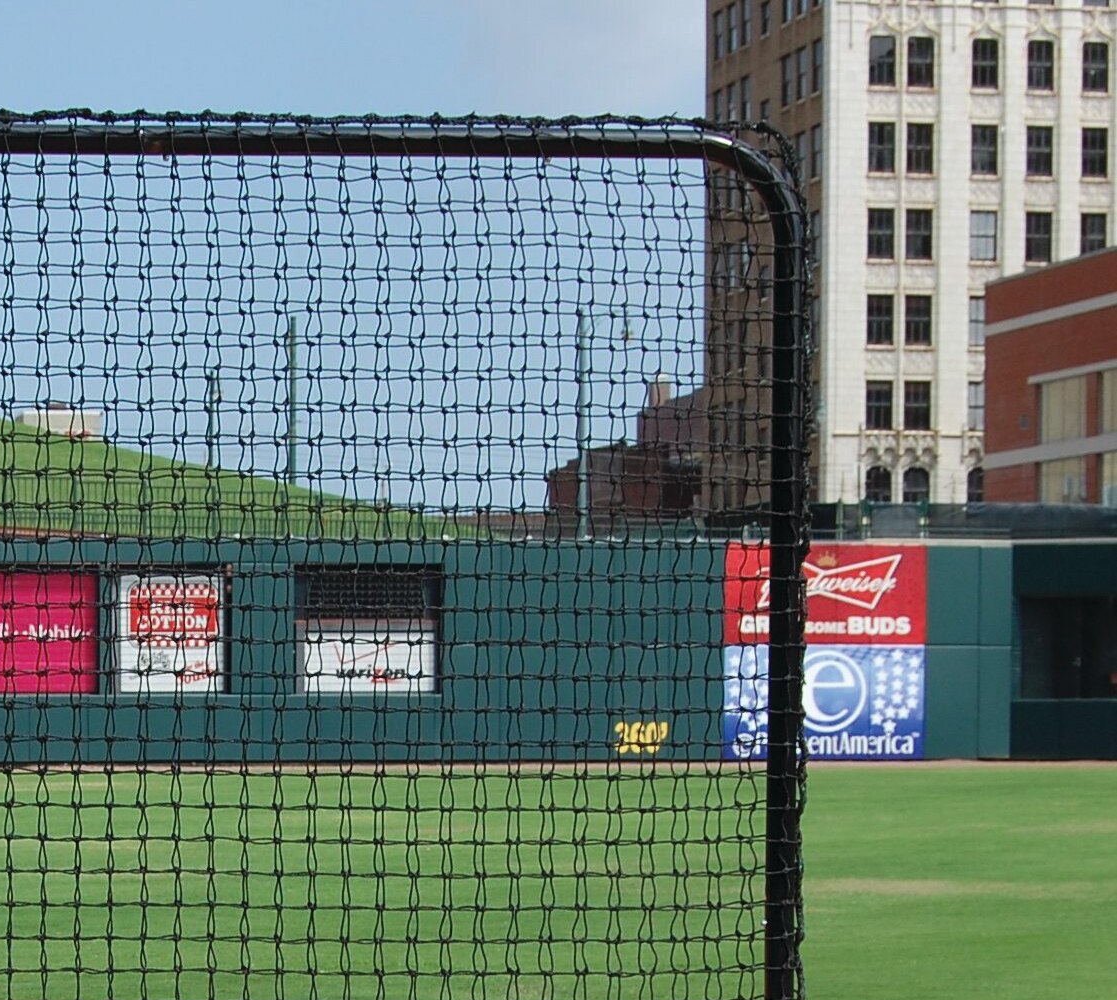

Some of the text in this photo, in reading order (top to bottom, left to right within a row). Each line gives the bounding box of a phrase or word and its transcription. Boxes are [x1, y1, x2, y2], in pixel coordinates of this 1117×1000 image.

[756, 566, 897, 608] dweiser
[137, 615, 208, 629] COTTON
[848, 615, 911, 635] BUDS
